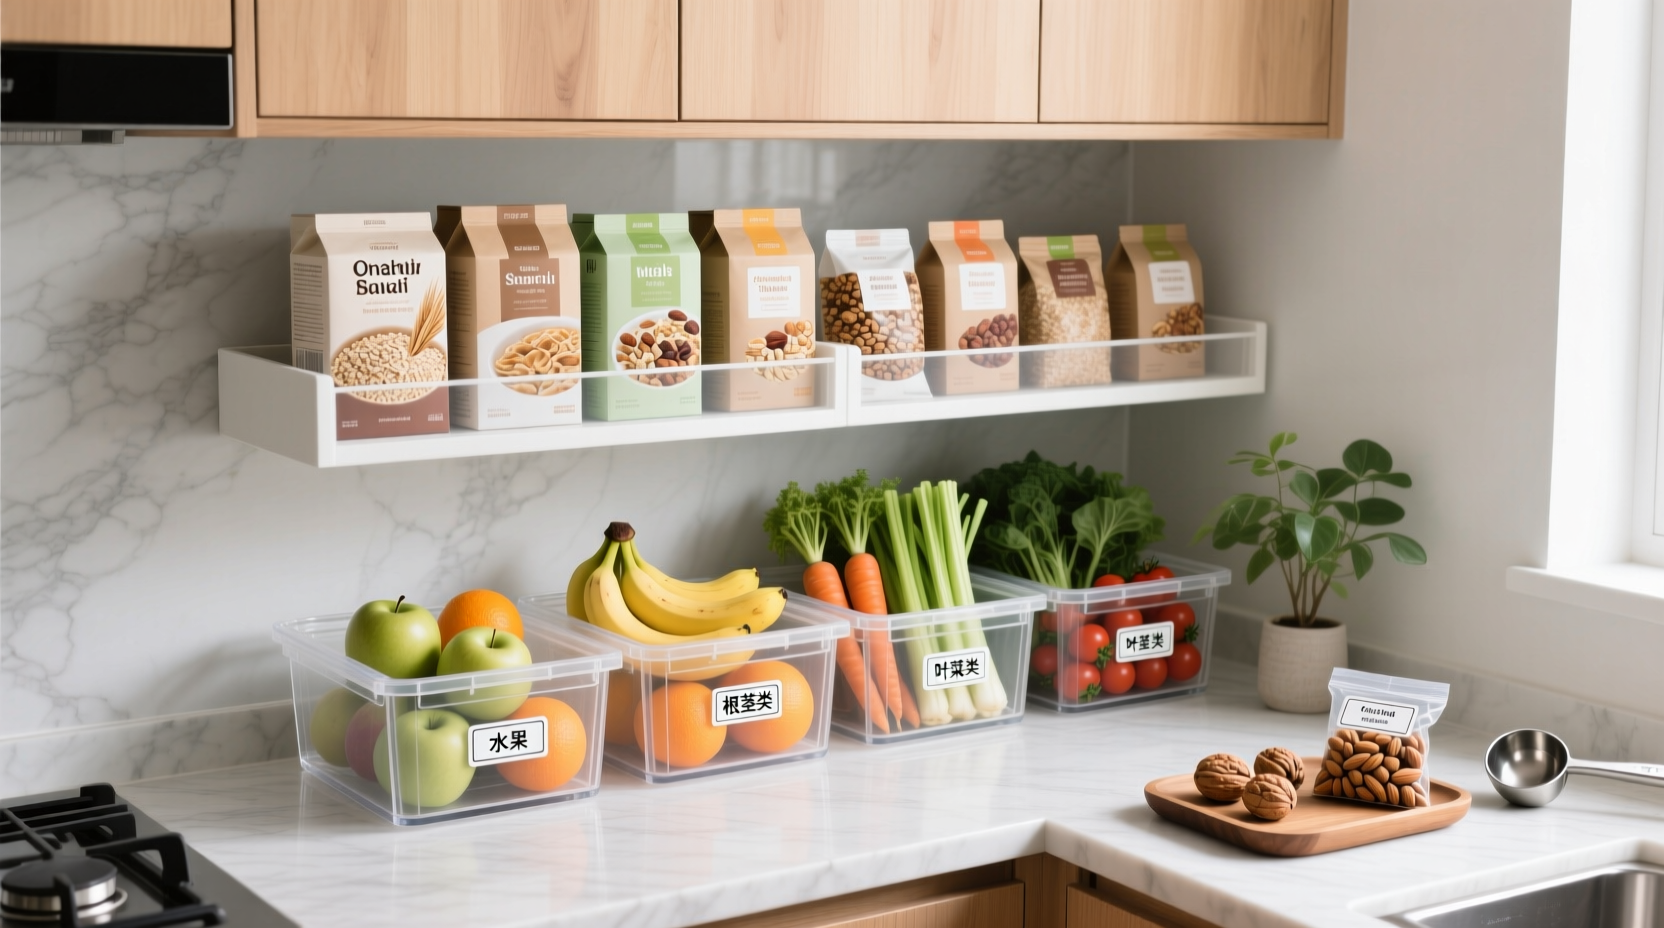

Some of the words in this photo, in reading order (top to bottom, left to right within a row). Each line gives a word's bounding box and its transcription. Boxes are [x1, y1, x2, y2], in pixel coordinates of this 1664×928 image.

[934, 657, 979, 681] 叶菜类
[722, 690, 773, 716] 根茎类
[489, 729, 528, 753] 水果
